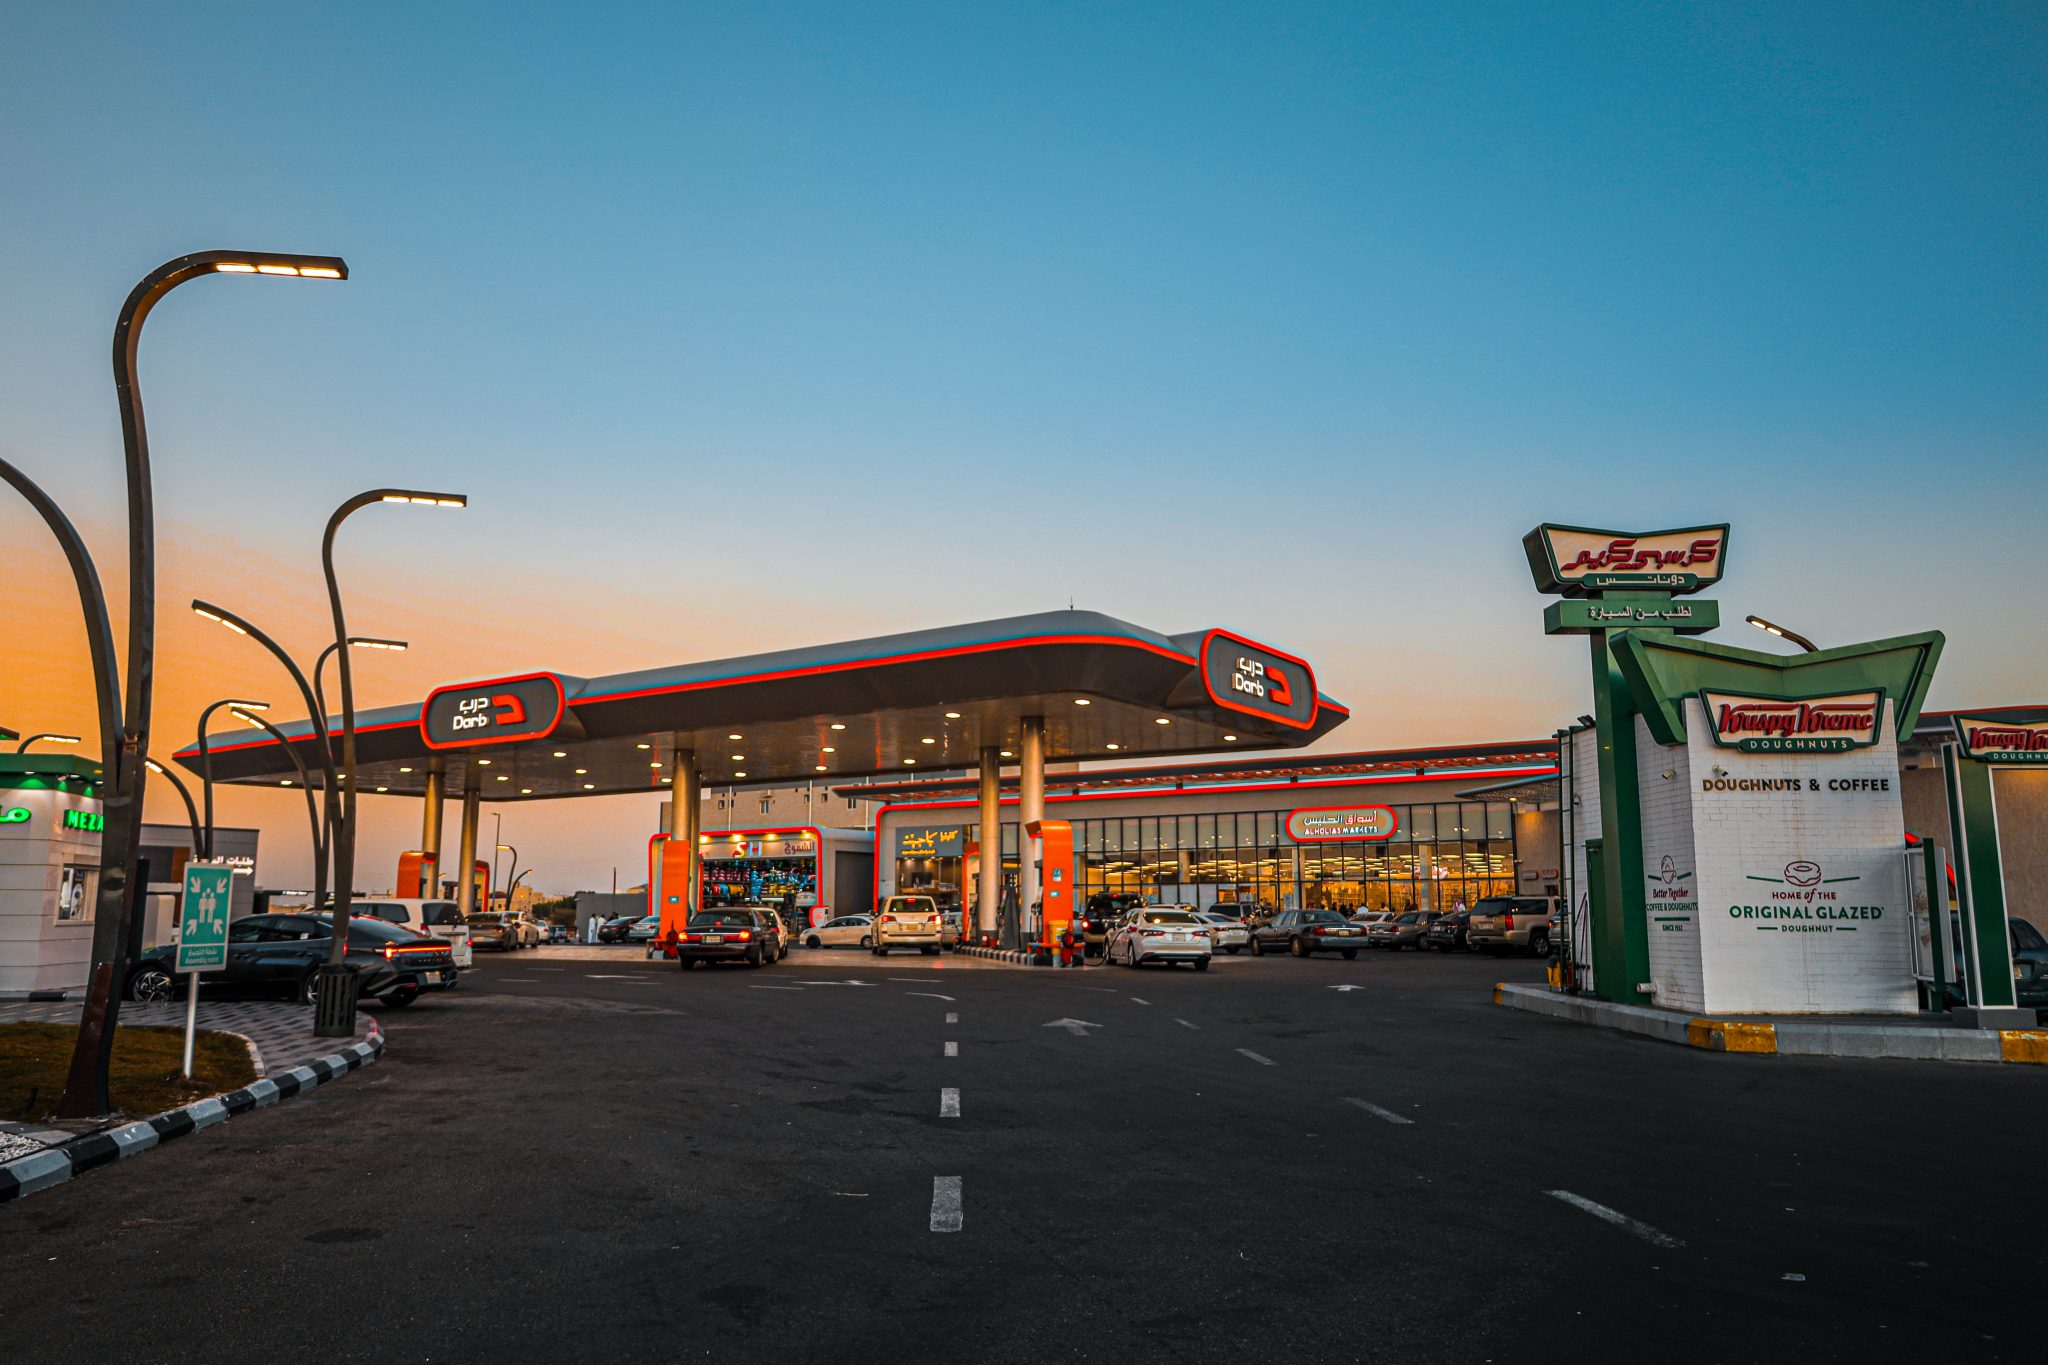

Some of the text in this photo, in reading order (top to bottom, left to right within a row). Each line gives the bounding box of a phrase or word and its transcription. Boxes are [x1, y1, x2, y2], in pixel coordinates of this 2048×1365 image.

[1560, 538, 1720, 571] كرسبي كريم
[1589, 605, 1632, 620] السيارة
[1635, 607, 1659, 620] من
[1239, 657, 1264, 677] درب
[1235, 673, 1264, 697] Darb
[459, 697, 488, 714] درب
[453, 713, 488, 730] Darb
[1718, 703, 1876, 737] Krispy Kreme
[1750, 740, 1848, 749] DOUGHNUTS
[1702, 779, 1890, 791] DOUGHNUTS & COFFEE
[1345, 810, 1377, 825] أسواق
[1342, 825, 1378, 835] MARKETS
[1652, 886, 1689, 901] Better Together
[1771, 888, 1837, 903] HOME of THE
[1646, 902, 1664, 911] COFFEE
[1668, 902, 1698, 911] DOUGHNUTS
[1729, 905, 1813, 919] ORIGINAL
[1781, 925, 1834, 933] DOUGHNUT
